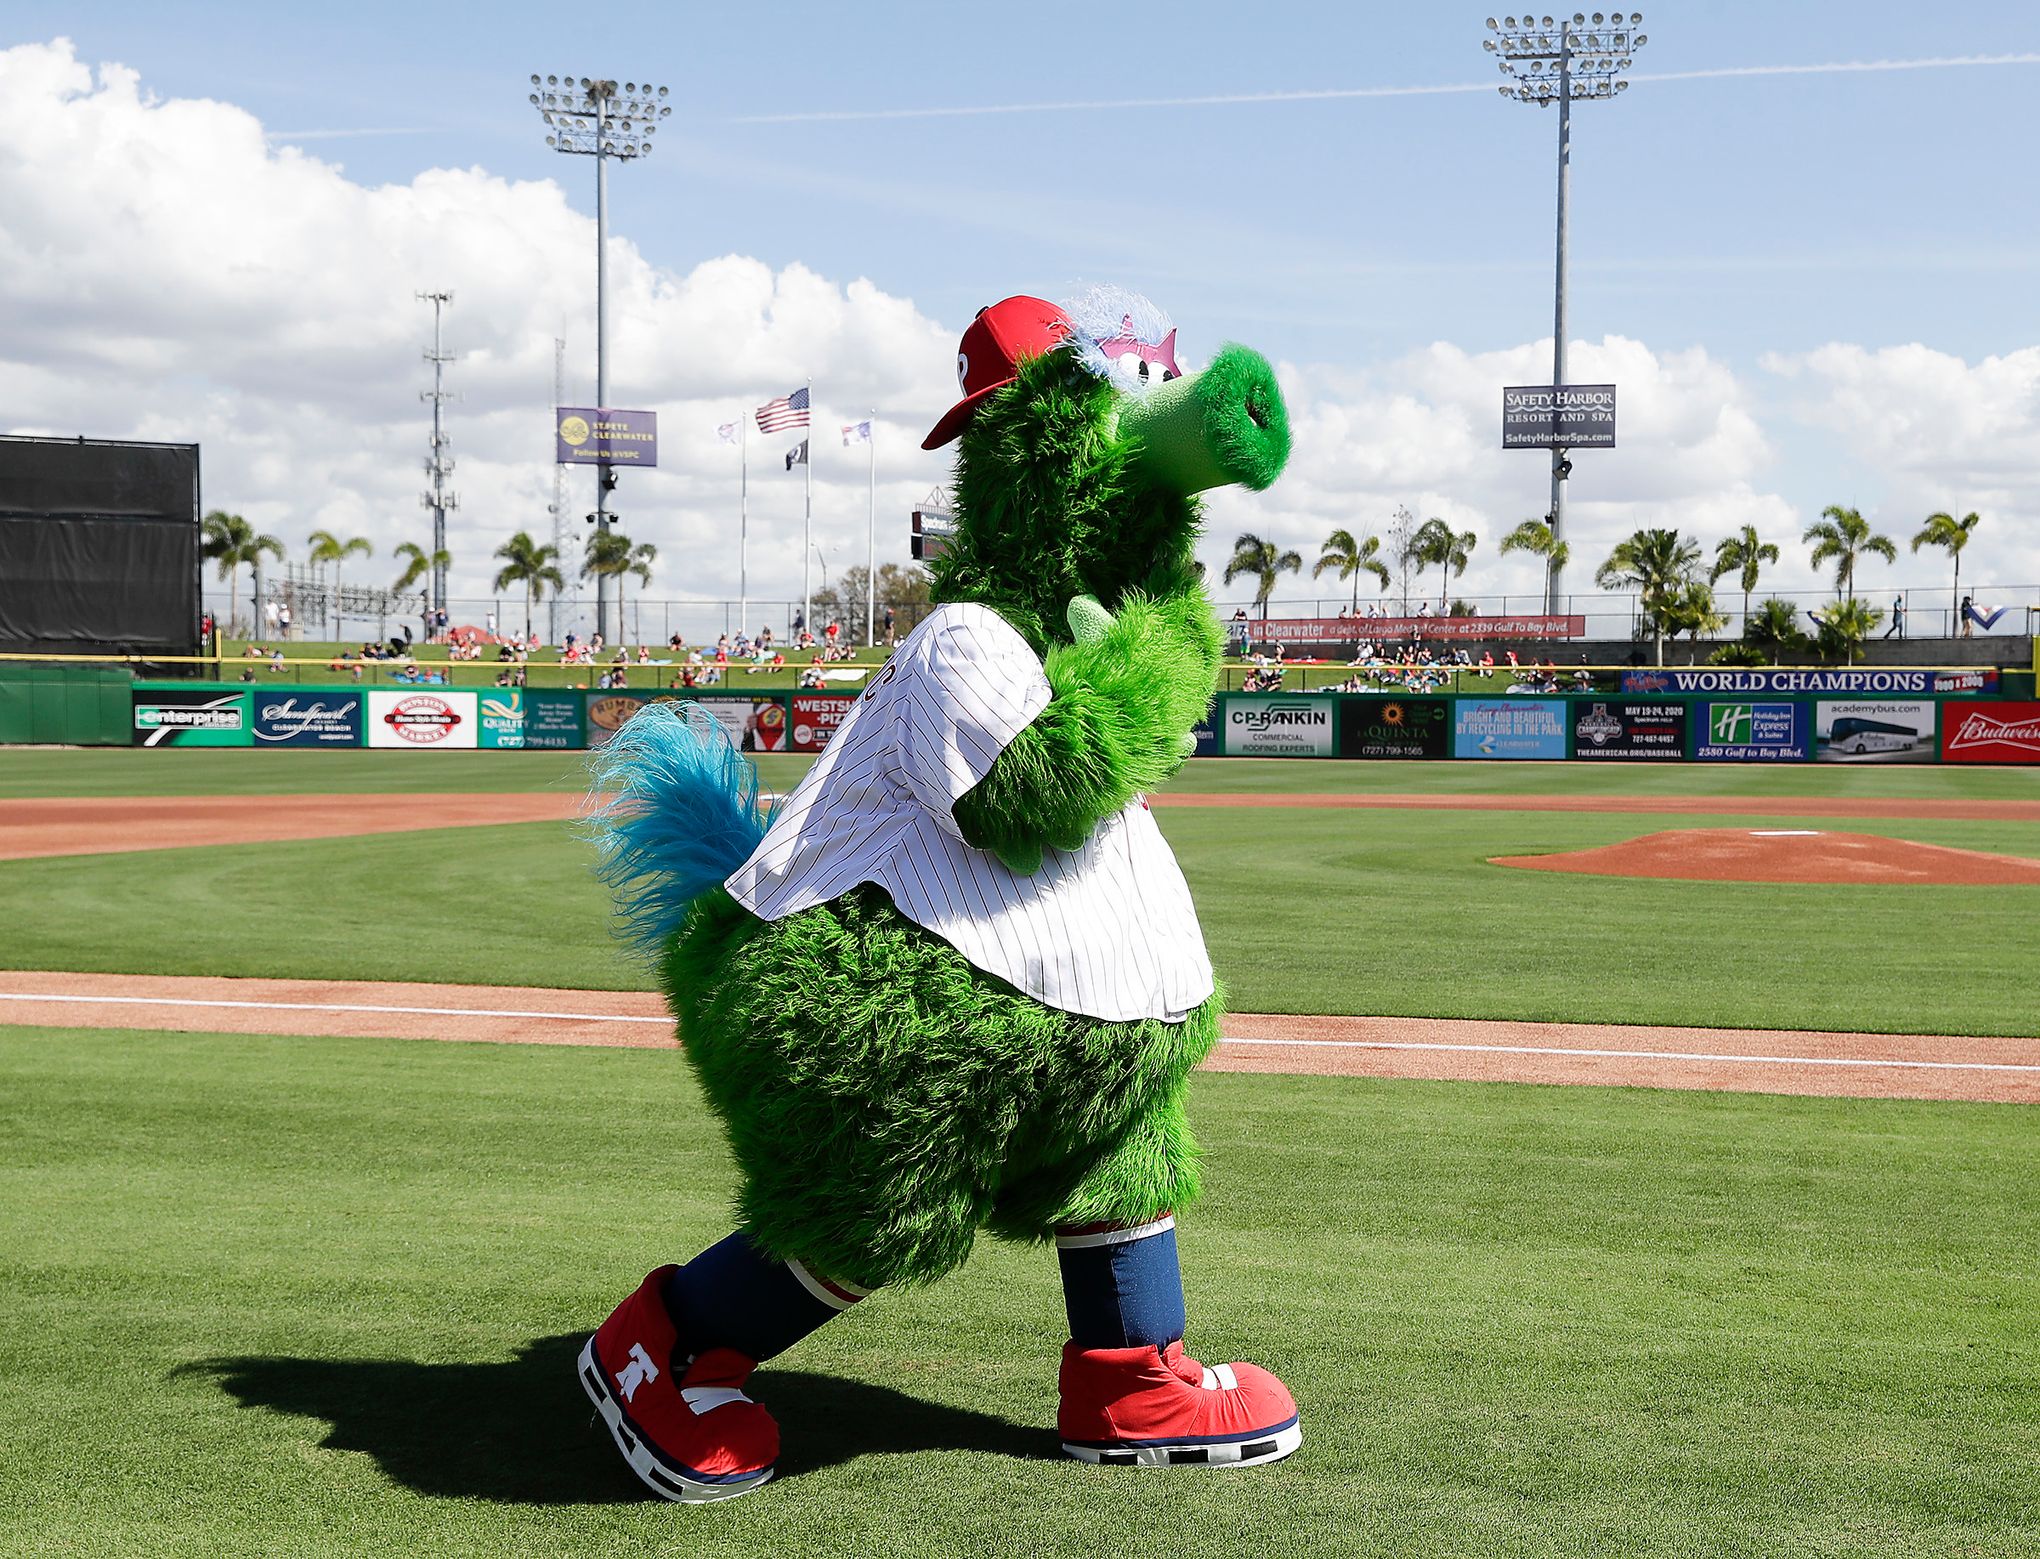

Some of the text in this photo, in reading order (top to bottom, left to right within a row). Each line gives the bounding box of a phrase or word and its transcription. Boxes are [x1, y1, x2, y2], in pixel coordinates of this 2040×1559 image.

[1506, 392, 1614, 406] SAFETY HARBOR
[1507, 413, 1613, 423] RESORT AND SPA
[592, 431, 655, 441] CLEARWATER
[1506, 432, 1612, 443] SafetyHarborSpa.com
[1253, 624, 1263, 636] in
[1265, 623, 1325, 637] Clearwater
[1369, 624, 1392, 636] Largo
[1429, 625, 1456, 635] Center
[1459, 625, 1469, 635] at
[1471, 625, 1493, 634] 2339
[1494, 623, 1514, 633] Gulf
[1515, 624, 1526, 633] To
[1527, 624, 1545, 635] Bay
[1546, 622, 1569, 633] Blvd.
[1675, 672, 1767, 691] WORLD
[1771, 672, 1926, 691] CHAMPIONS
[595, 700, 640, 714] RUMB
[796, 700, 856, 713] WESTSH
[1625, 706, 1641, 716] MAY
[1665, 706, 1684, 716] 2020
[1831, 704, 1921, 715] academybus.com
[142, 710, 240, 726] enterprise
[1463, 711, 1556, 724] BRIGHT AND BEAUTIFUL
[1753, 711, 1779, 720] Holiday
[483, 718, 529, 729] QUALITY
[1456, 723, 1467, 735] BY
[1468, 723, 1511, 735] RECYCLING
[1513, 723, 1522, 735] IN
[1525, 723, 1539, 735] THE
[1753, 721, 1789, 731] Express
[1252, 733, 1305, 741] COMMERCIAL
[1368, 725, 1430, 741] QUINTA
[1242, 745, 1315, 753] ROOFING EXPERTS
[1362, 746, 1384, 756] (727)
[1577, 748, 1682, 757] THEAMERICAN.ORG/BASEBALL
[1698, 747, 1804, 759] 2580 Gulf to Bay Blvd.
